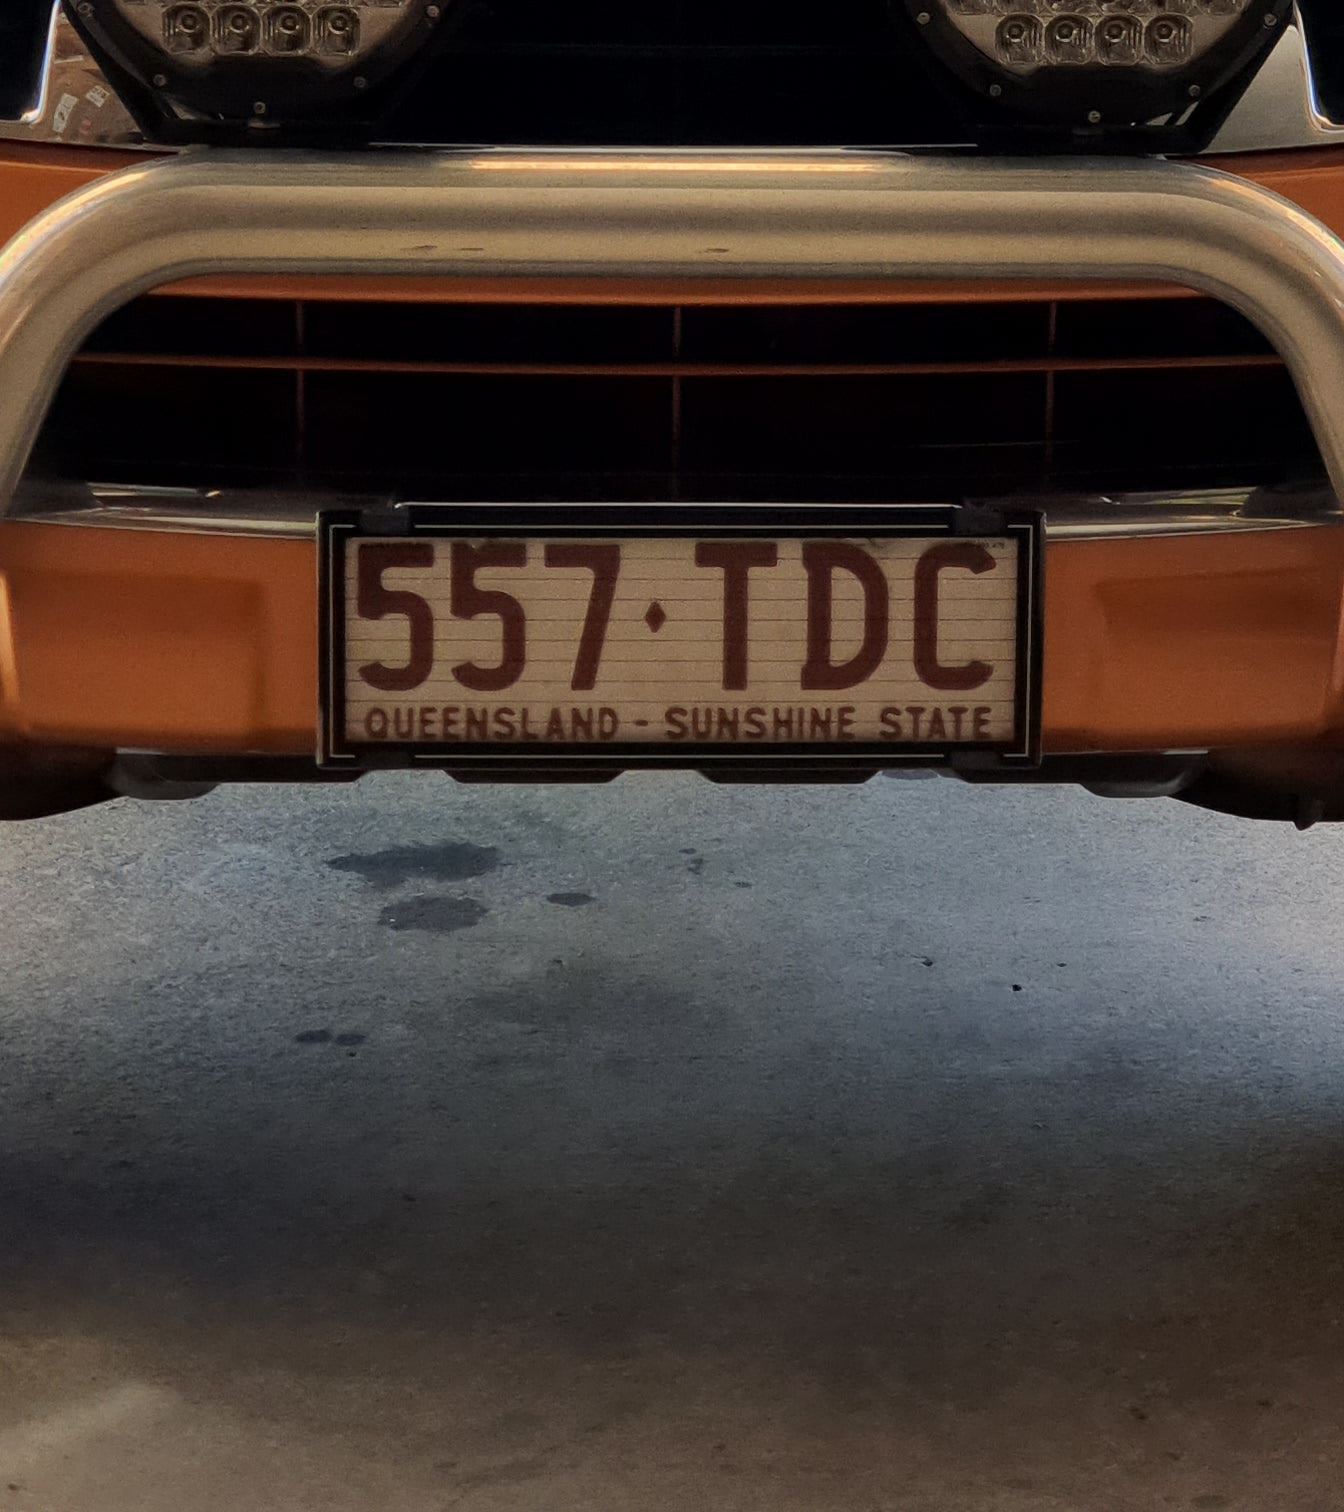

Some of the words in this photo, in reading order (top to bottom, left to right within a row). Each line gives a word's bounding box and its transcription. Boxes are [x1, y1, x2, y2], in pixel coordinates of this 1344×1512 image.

[364, 706, 620, 741] QUEENSLAND
[665, 706, 856, 742] SUNSHINE
[879, 706, 994, 741] STATE
